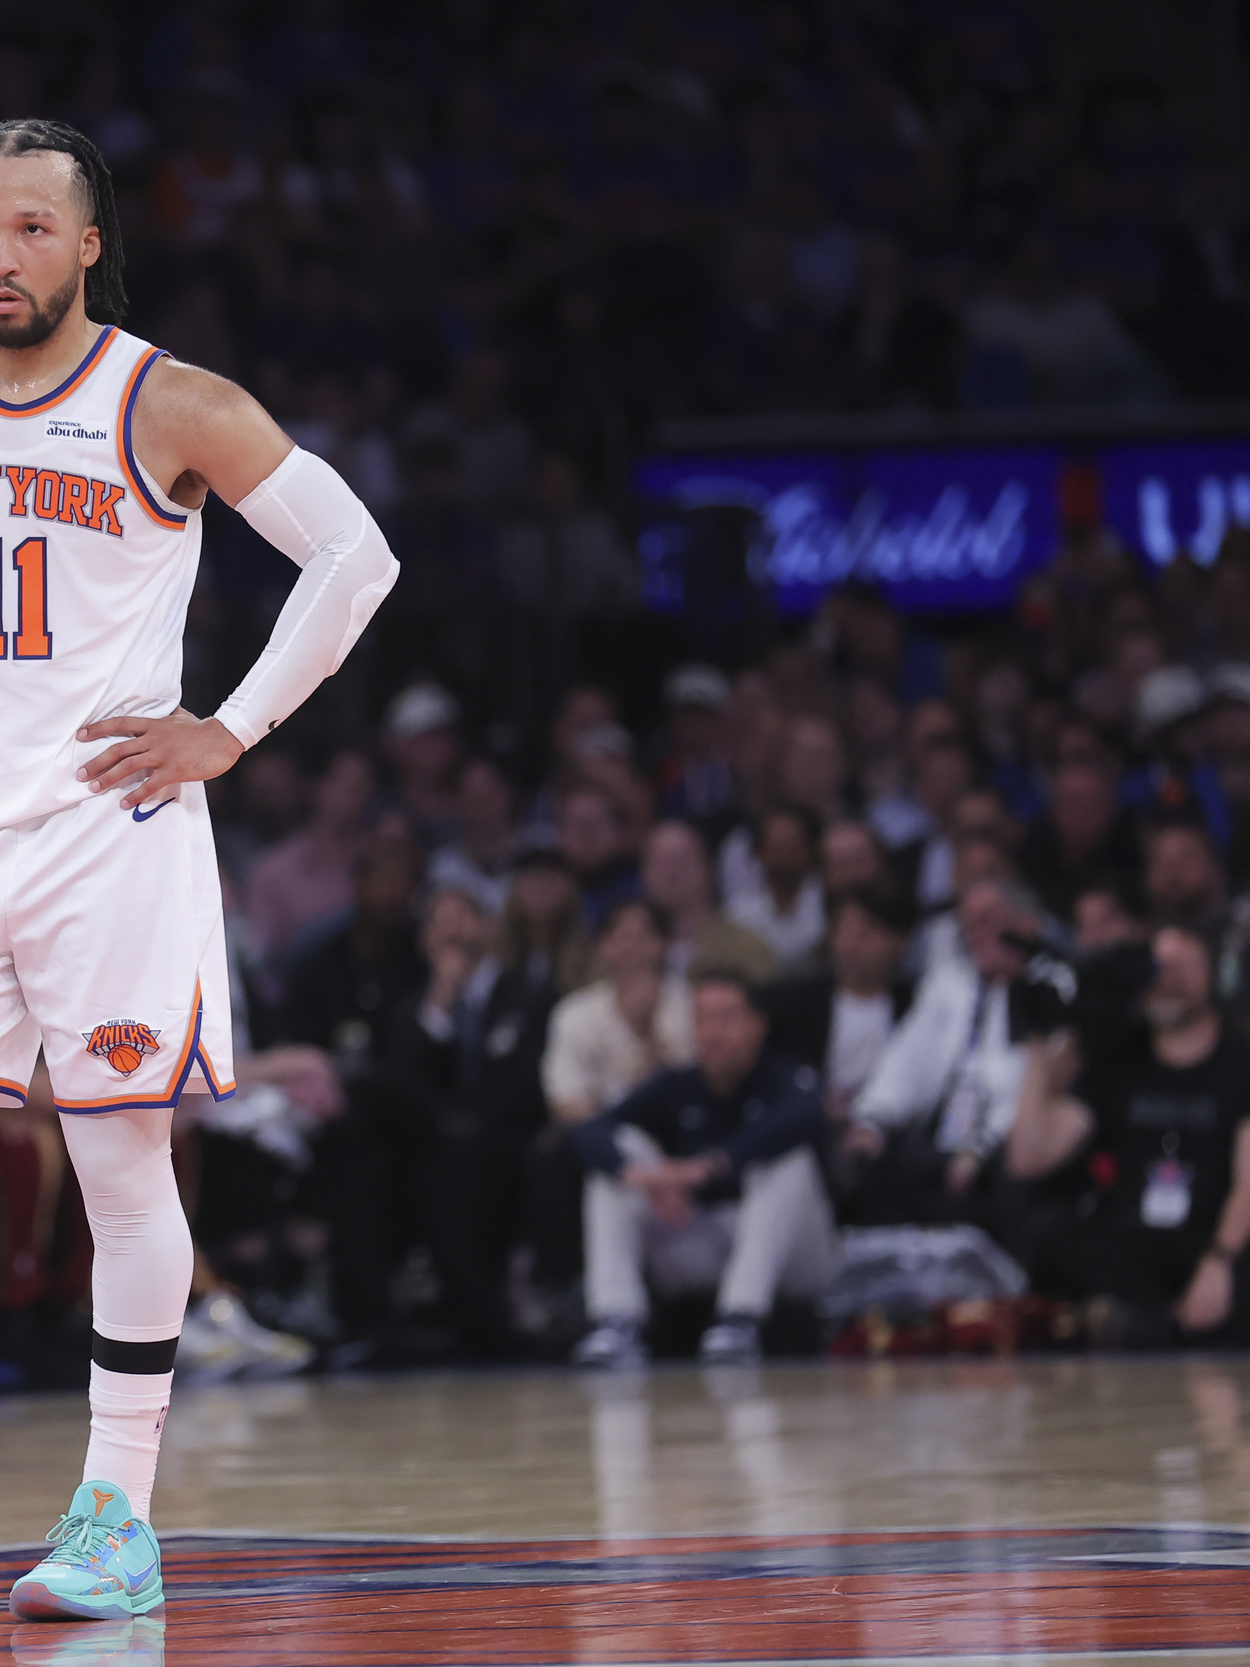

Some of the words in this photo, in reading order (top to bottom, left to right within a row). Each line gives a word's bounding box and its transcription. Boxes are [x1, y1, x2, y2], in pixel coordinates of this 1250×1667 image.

[47, 426, 70, 437] abu
[72, 428, 108, 440] dhabi
[5, 465, 125, 538] YORK
[86, 1023, 160, 1055] KNICKS
